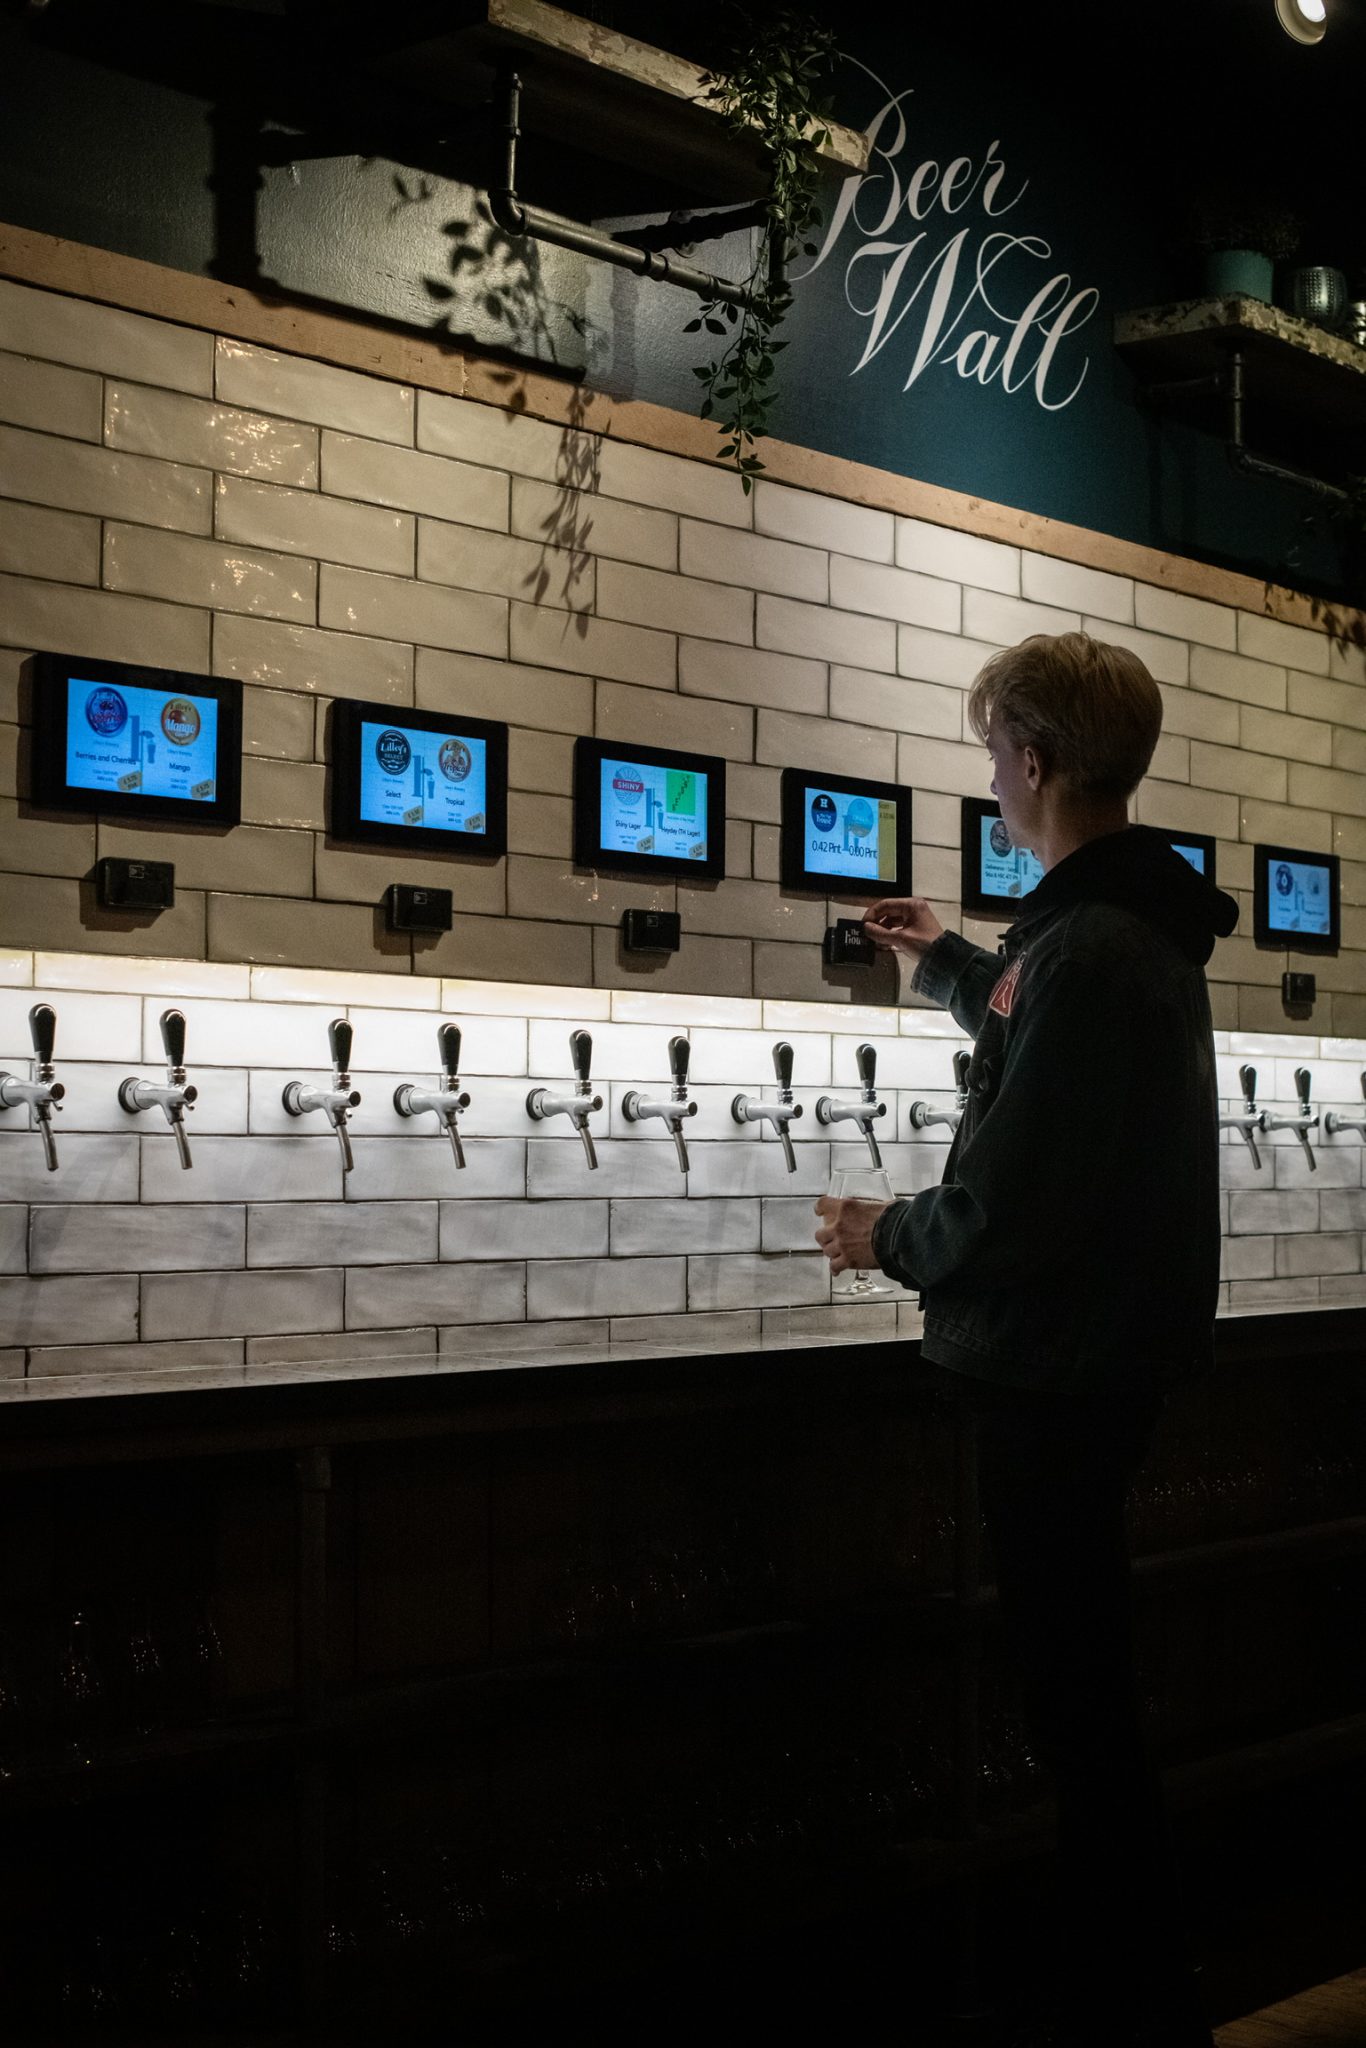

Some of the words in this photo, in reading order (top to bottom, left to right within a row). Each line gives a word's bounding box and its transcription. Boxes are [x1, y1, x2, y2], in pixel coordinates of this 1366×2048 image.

[789, 52, 1029, 281] Beer
[845, 227, 1099, 411] Wall
[169, 762, 191, 773] Mango
[617, 781, 641, 791] SHINY
[385, 790, 402, 799] Select
[445, 797, 465, 807] Tropical
[615, 819, 628, 829] Shiny
[628, 822, 642, 830] Lager
[811, 840, 828, 853] 0.42
